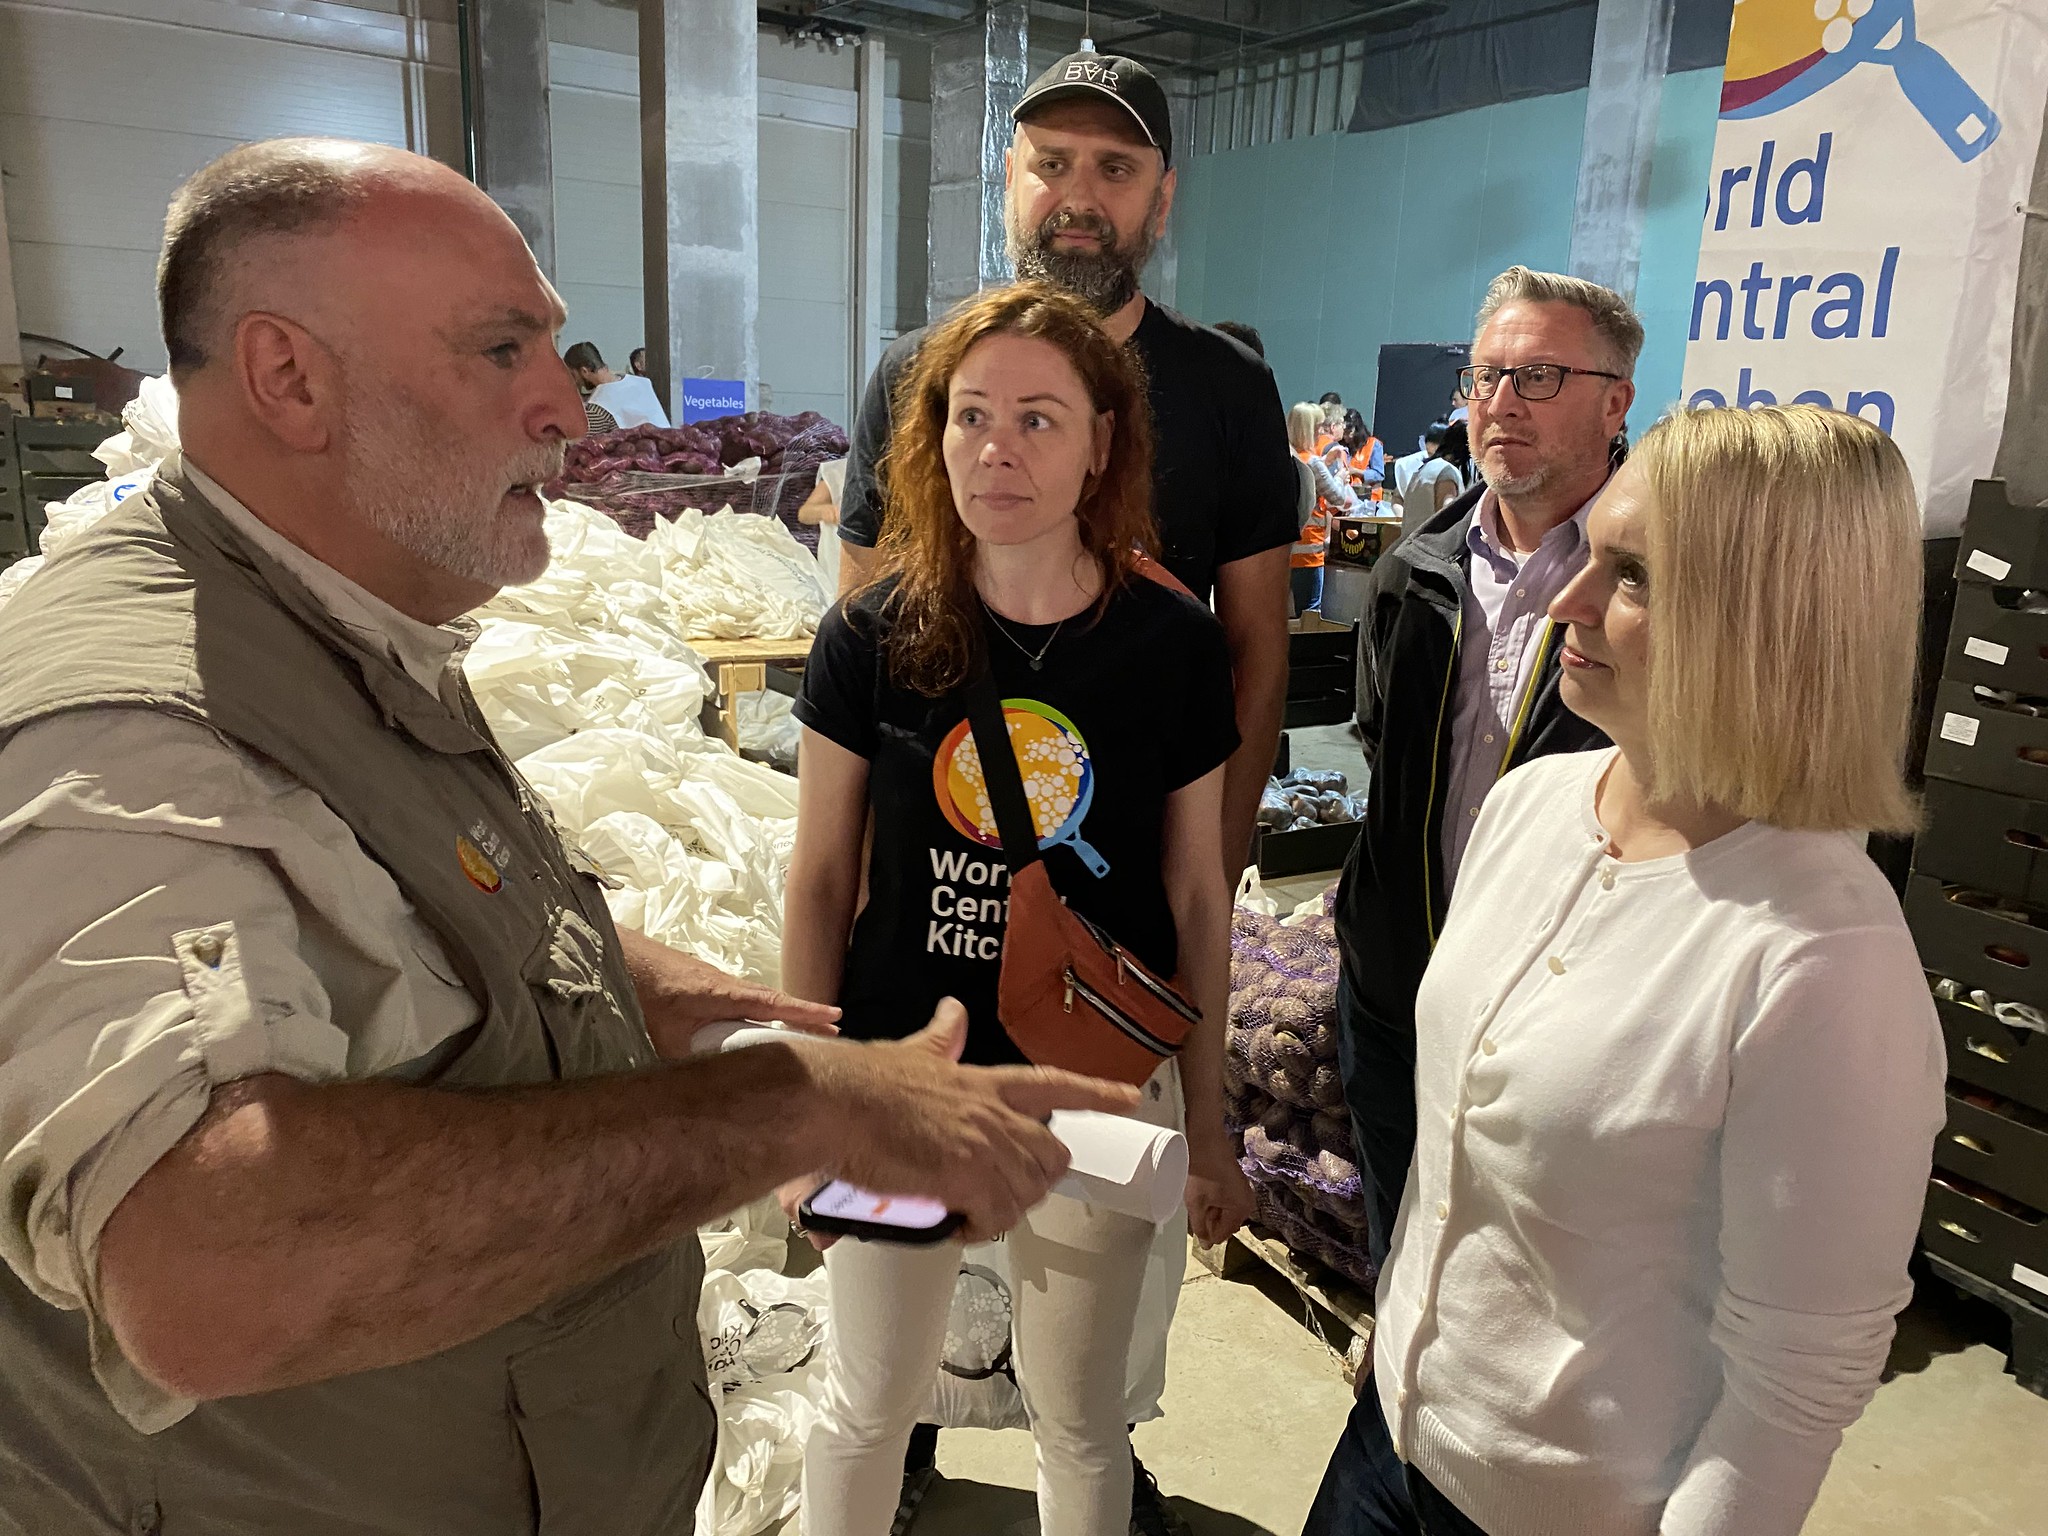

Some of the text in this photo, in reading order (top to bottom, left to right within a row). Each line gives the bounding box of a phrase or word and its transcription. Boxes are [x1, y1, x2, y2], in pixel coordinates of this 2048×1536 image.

[1704, 132, 1833, 231] rld
[1688, 246, 1900, 341] ntral
[684, 395, 744, 410] Vegetables
[929, 848, 1013, 888] Wor
[926, 920, 1000, 961] Kitc
